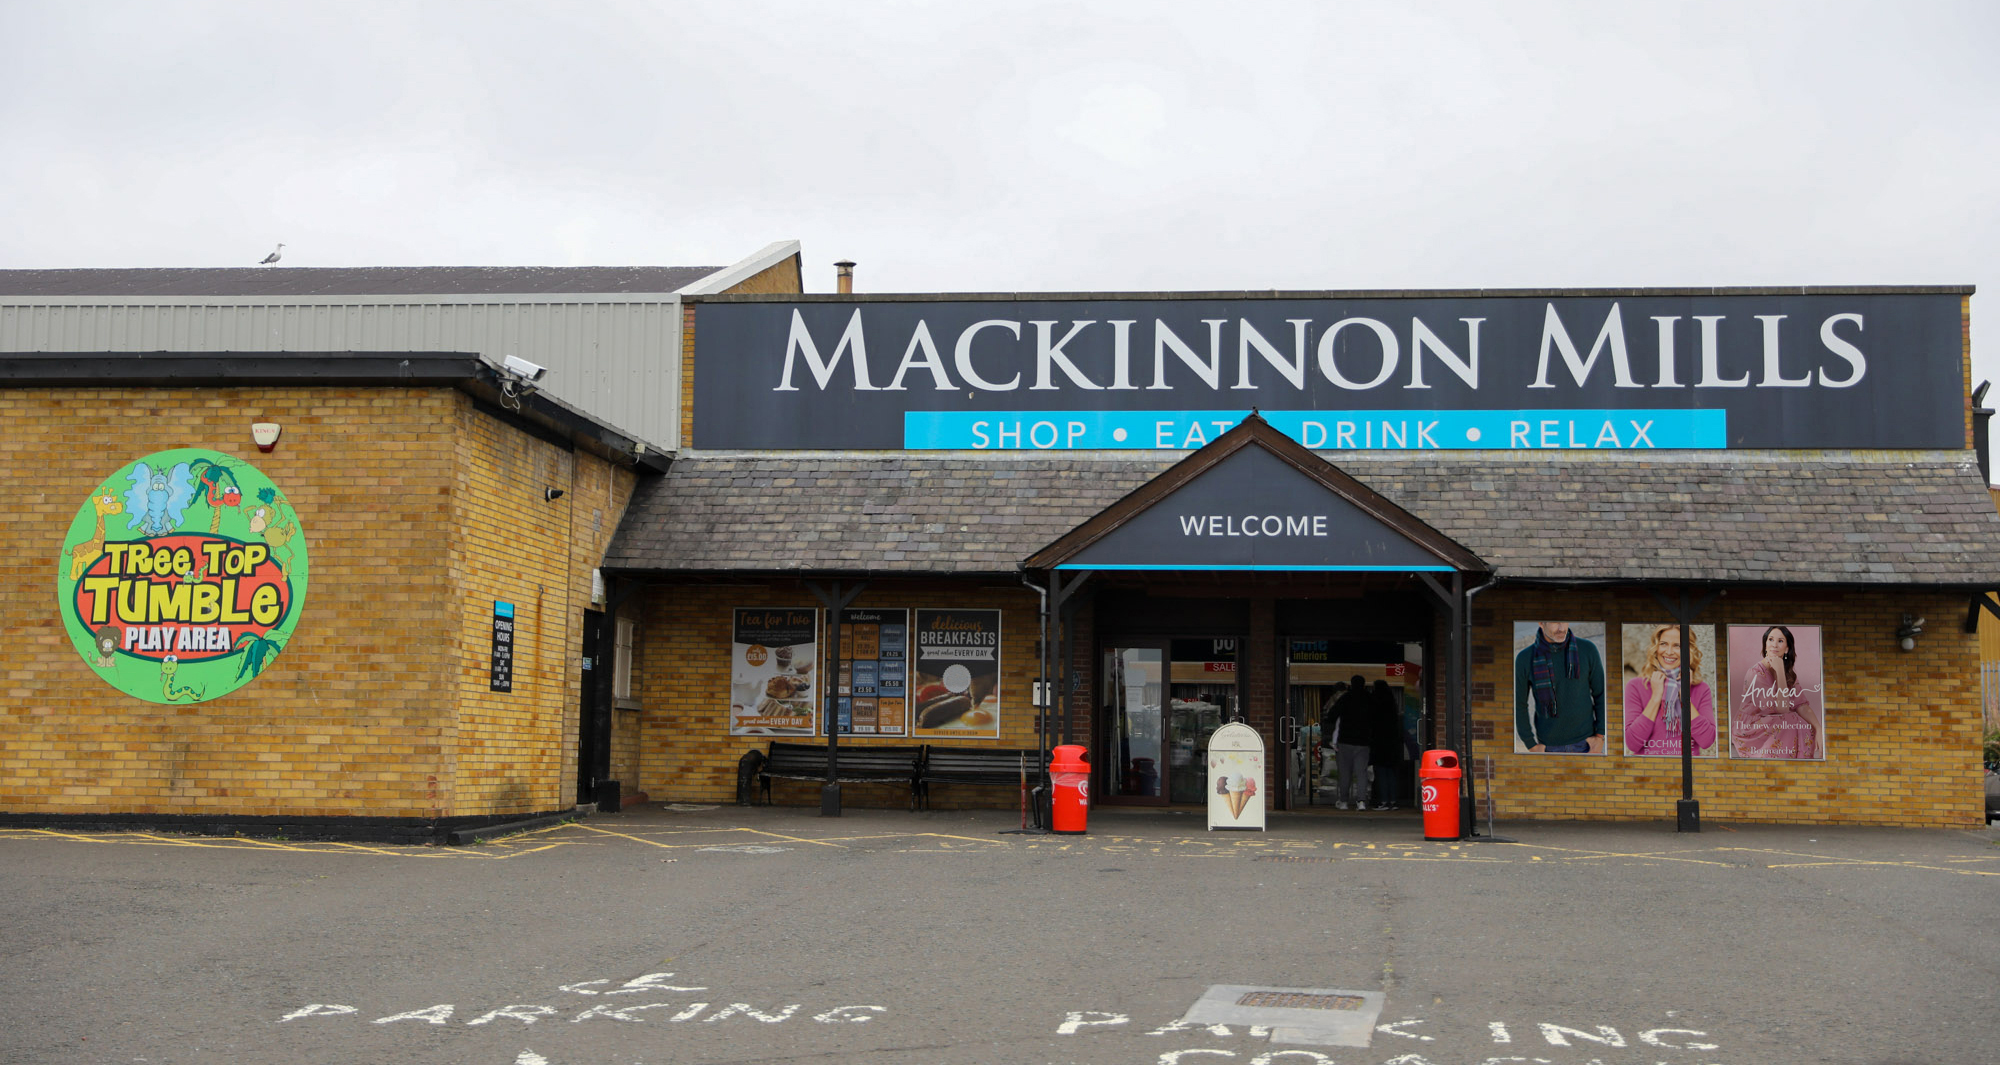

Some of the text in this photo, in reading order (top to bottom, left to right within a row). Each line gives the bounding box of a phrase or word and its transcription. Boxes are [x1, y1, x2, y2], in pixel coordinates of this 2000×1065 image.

[773, 302, 1867, 391] MACKINNON MILLS
[972, 420, 1654, 449] SHOP EAT DRINK RELAX
[1180, 515, 1328, 537] WELCOME
[850, 611, 881, 620] welcome
[495, 619, 513, 632] OPENING
[931, 616, 983, 634] delicious
[125, 626, 231, 651] PLAY AREA
[496, 632, 510, 643] HOURS
[920, 631, 996, 645] BREAKFASTS
[954, 649, 974, 657] EVERY
[976, 649, 988, 657] DAY
[1292, 651, 1328, 661] interiors
[1212, 663, 1237, 672] SALE
[1741, 674, 1803, 707] Andrea
[1758, 700, 1795, 708] LOVES
[1733, 720, 1751, 730] The
[1772, 720, 1812, 730] collection
[1643, 739, 1695, 748] LOCHMEE
[1750, 746, 1796, 755] Bonmarché
[1422, 804, 1437, 812] ALL'S
[277, 1002, 888, 1026] PARKING
[1056, 1010, 1719, 1049] PAKING
